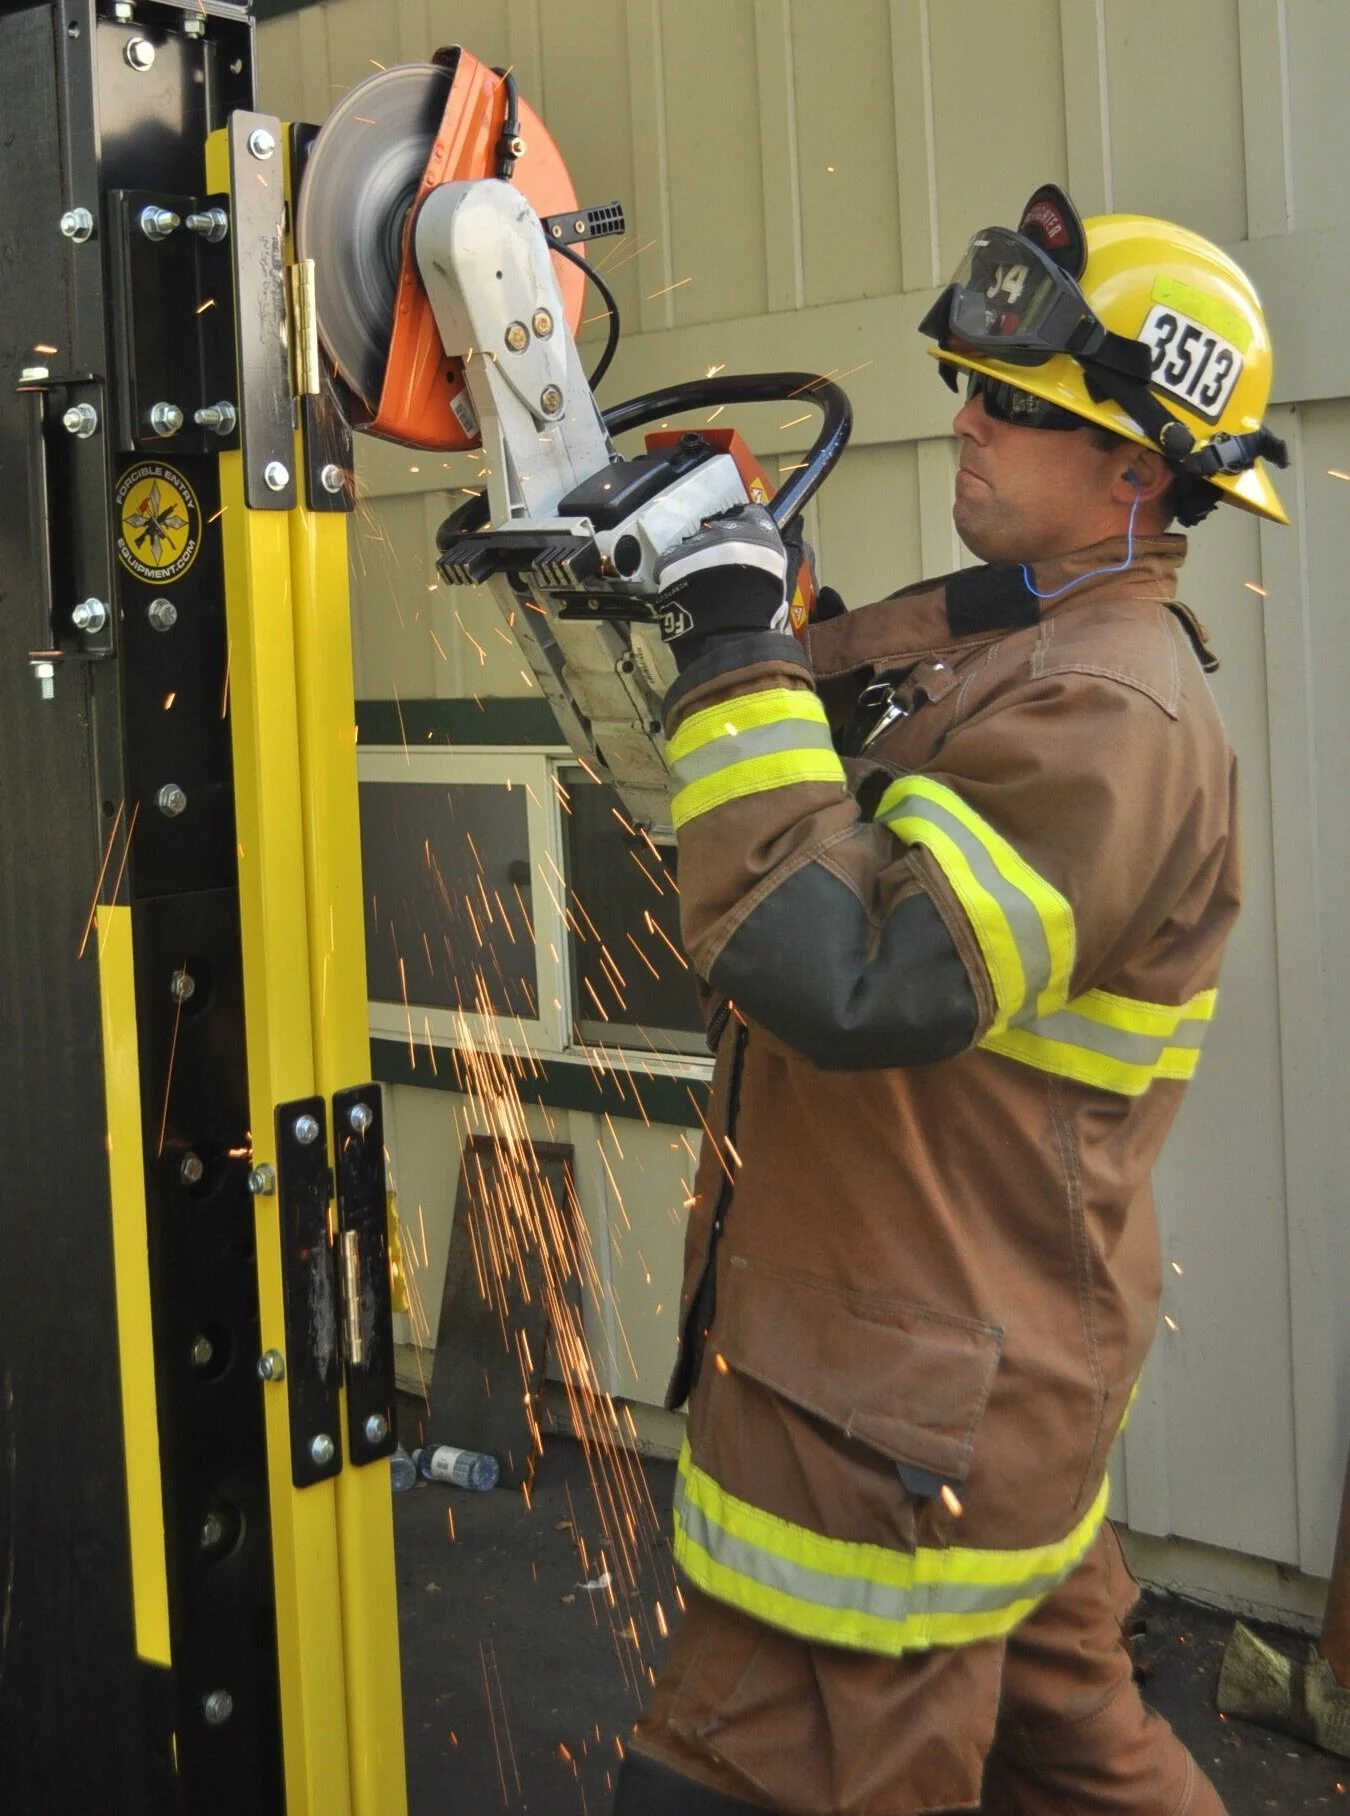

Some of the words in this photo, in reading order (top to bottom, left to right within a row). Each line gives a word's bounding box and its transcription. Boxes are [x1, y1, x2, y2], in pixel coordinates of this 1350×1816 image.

[1150, 313, 1233, 408] 3513
[116, 466, 162, 504] FORCIBLE
[164, 470, 195, 509] ENTRY
[118, 538, 196, 579] EQUIPMENT.COM
